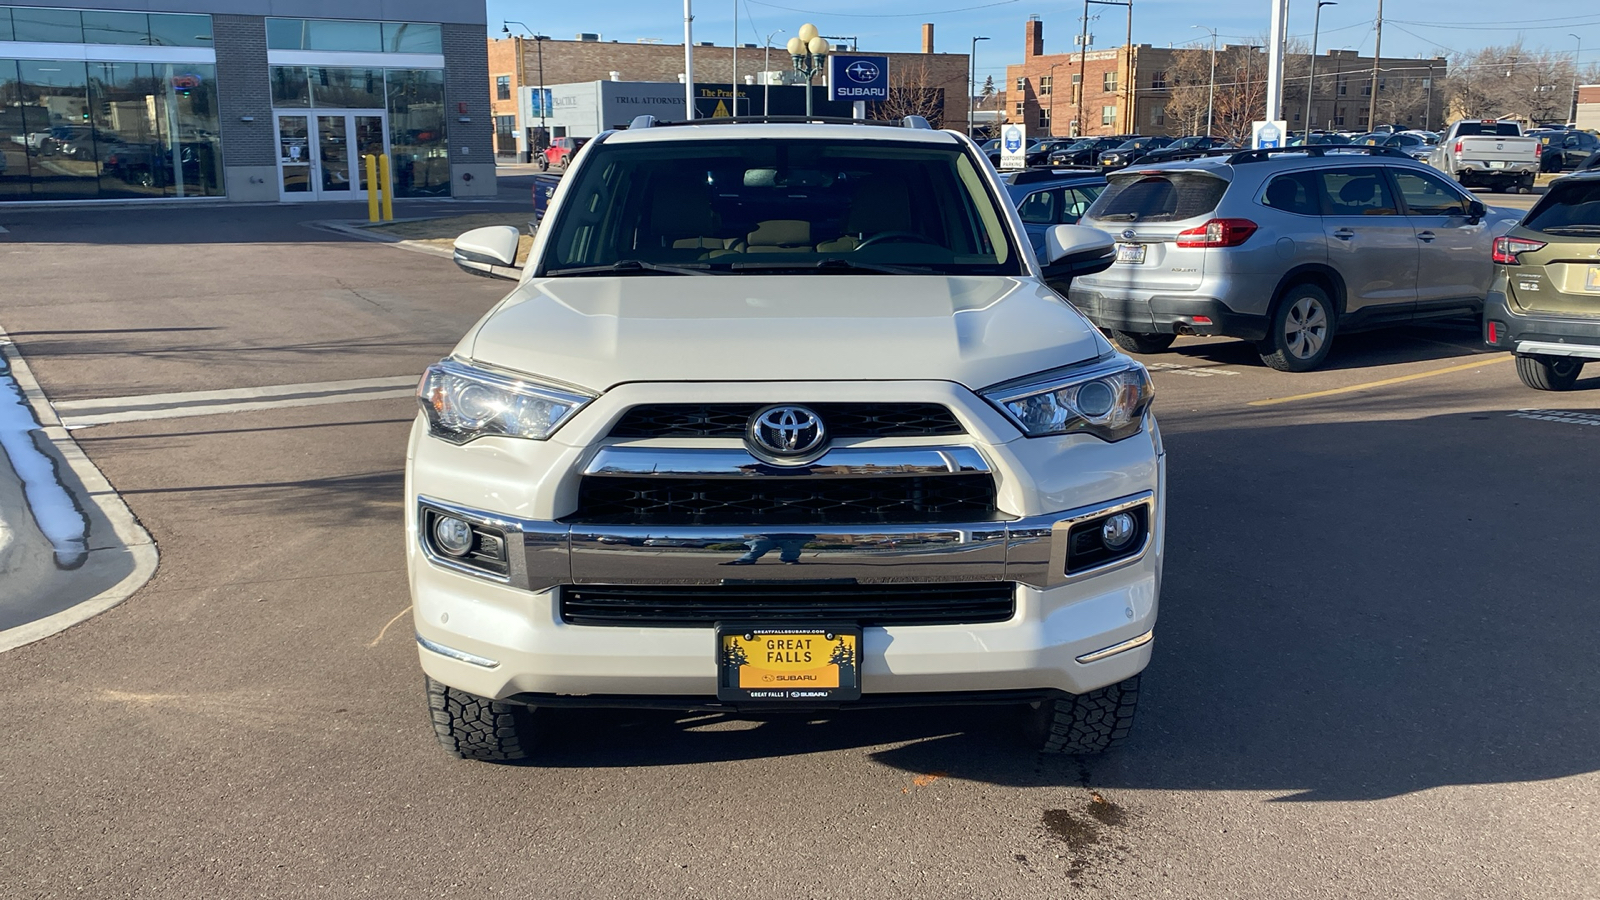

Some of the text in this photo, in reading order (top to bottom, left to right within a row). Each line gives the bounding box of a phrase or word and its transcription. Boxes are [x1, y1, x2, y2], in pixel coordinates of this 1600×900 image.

[701, 88, 746, 97] The Pracce
[837, 87, 885, 96] SUBARU
[615, 96, 687, 105] TRIAL ATTORNEYS
[766, 639, 812, 650] GREAT
[767, 651, 812, 663] FALLS
